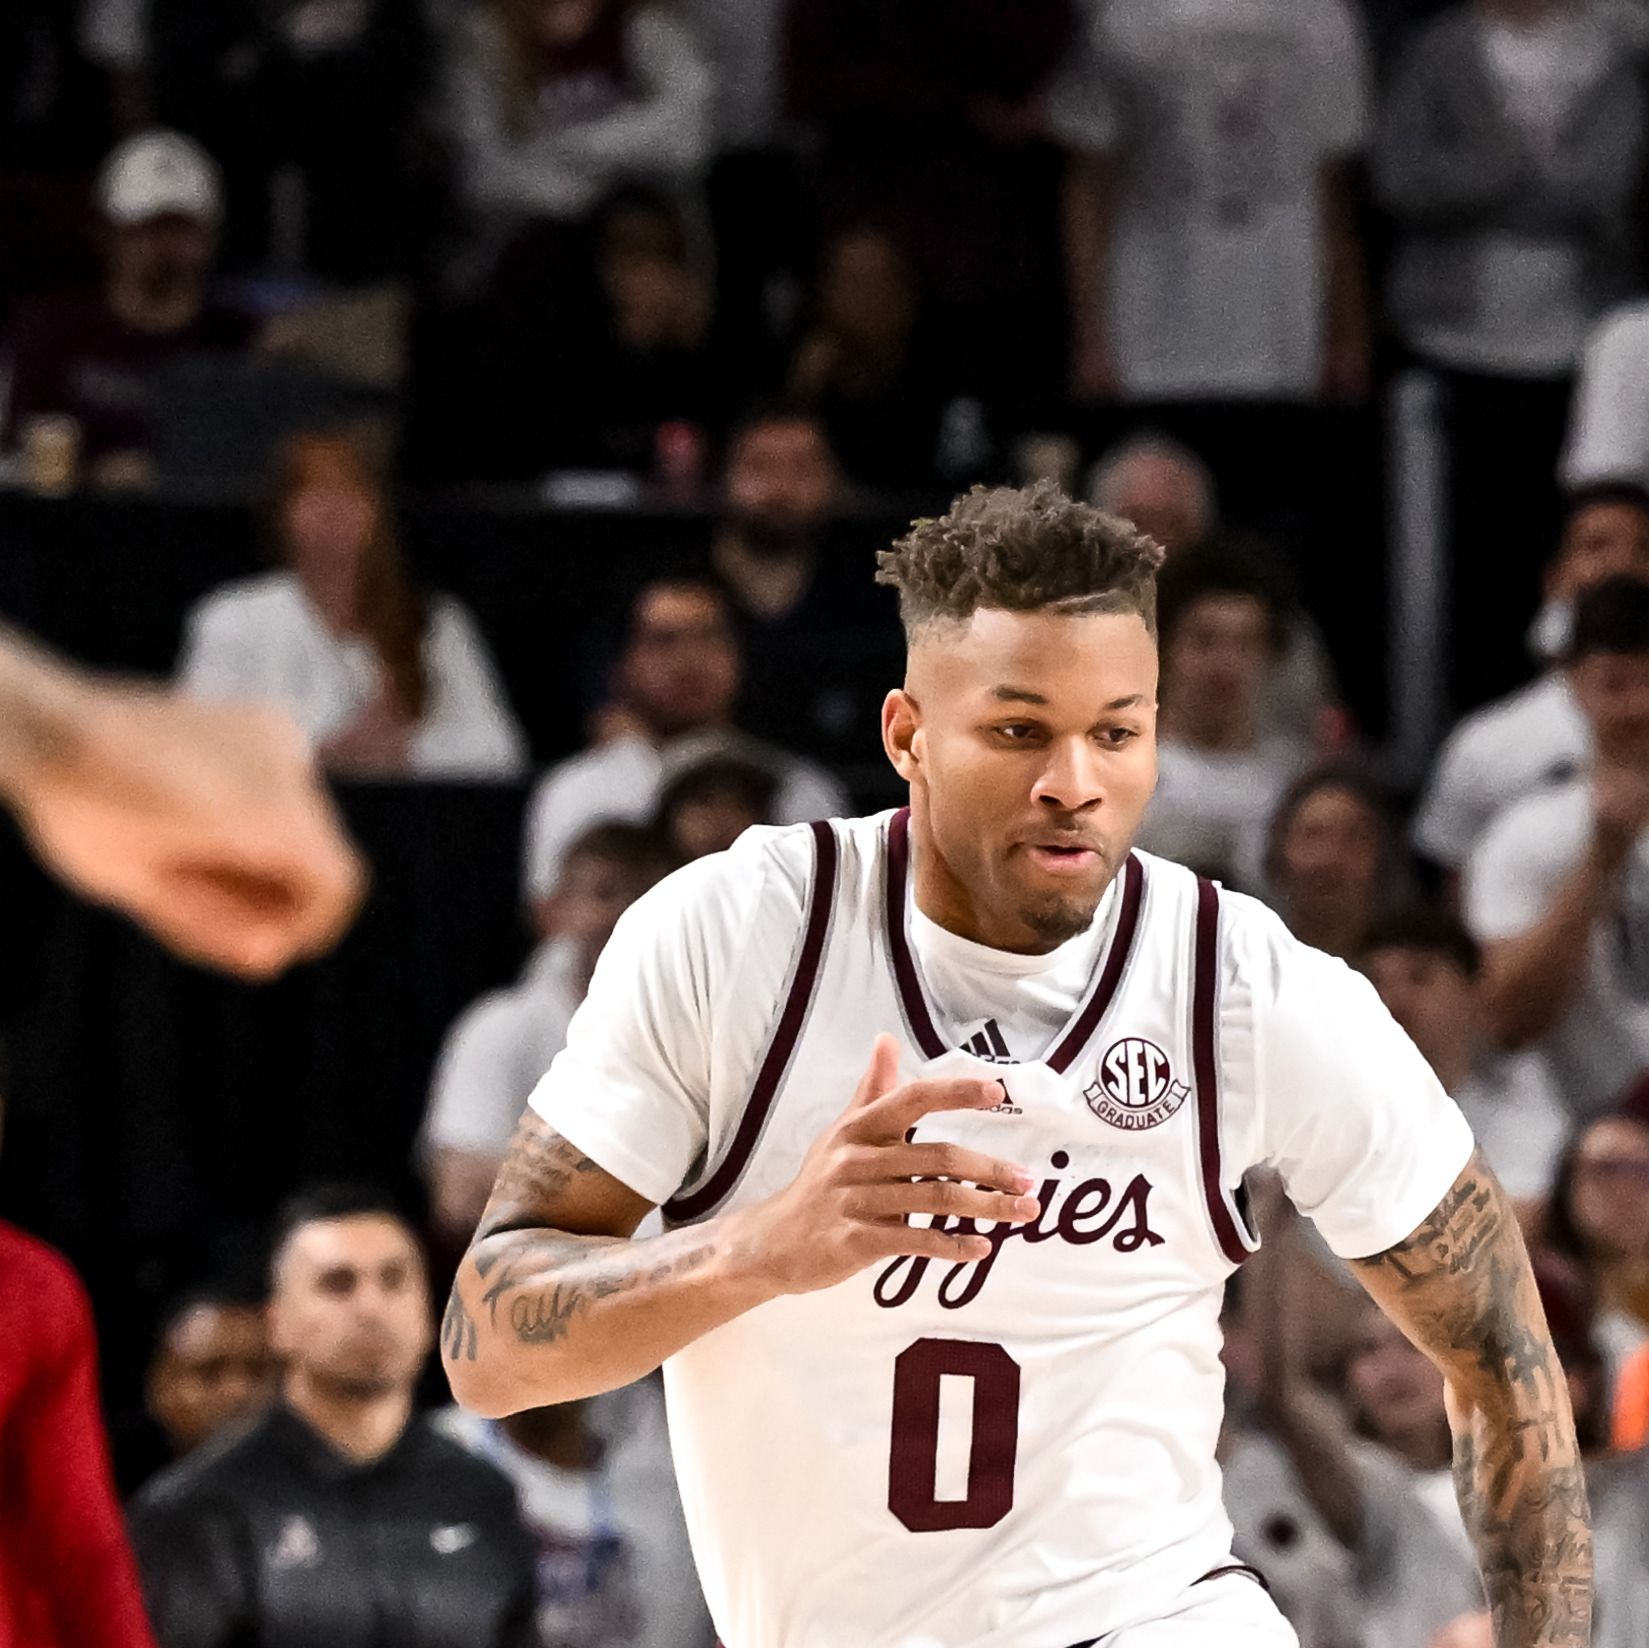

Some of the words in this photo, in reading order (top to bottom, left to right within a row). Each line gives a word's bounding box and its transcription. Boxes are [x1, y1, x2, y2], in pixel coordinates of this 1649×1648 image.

[1104, 1039, 1168, 1107] SEC
[1096, 1100, 1176, 1130] GRADUATE
[888, 1338, 1020, 1533] 0
